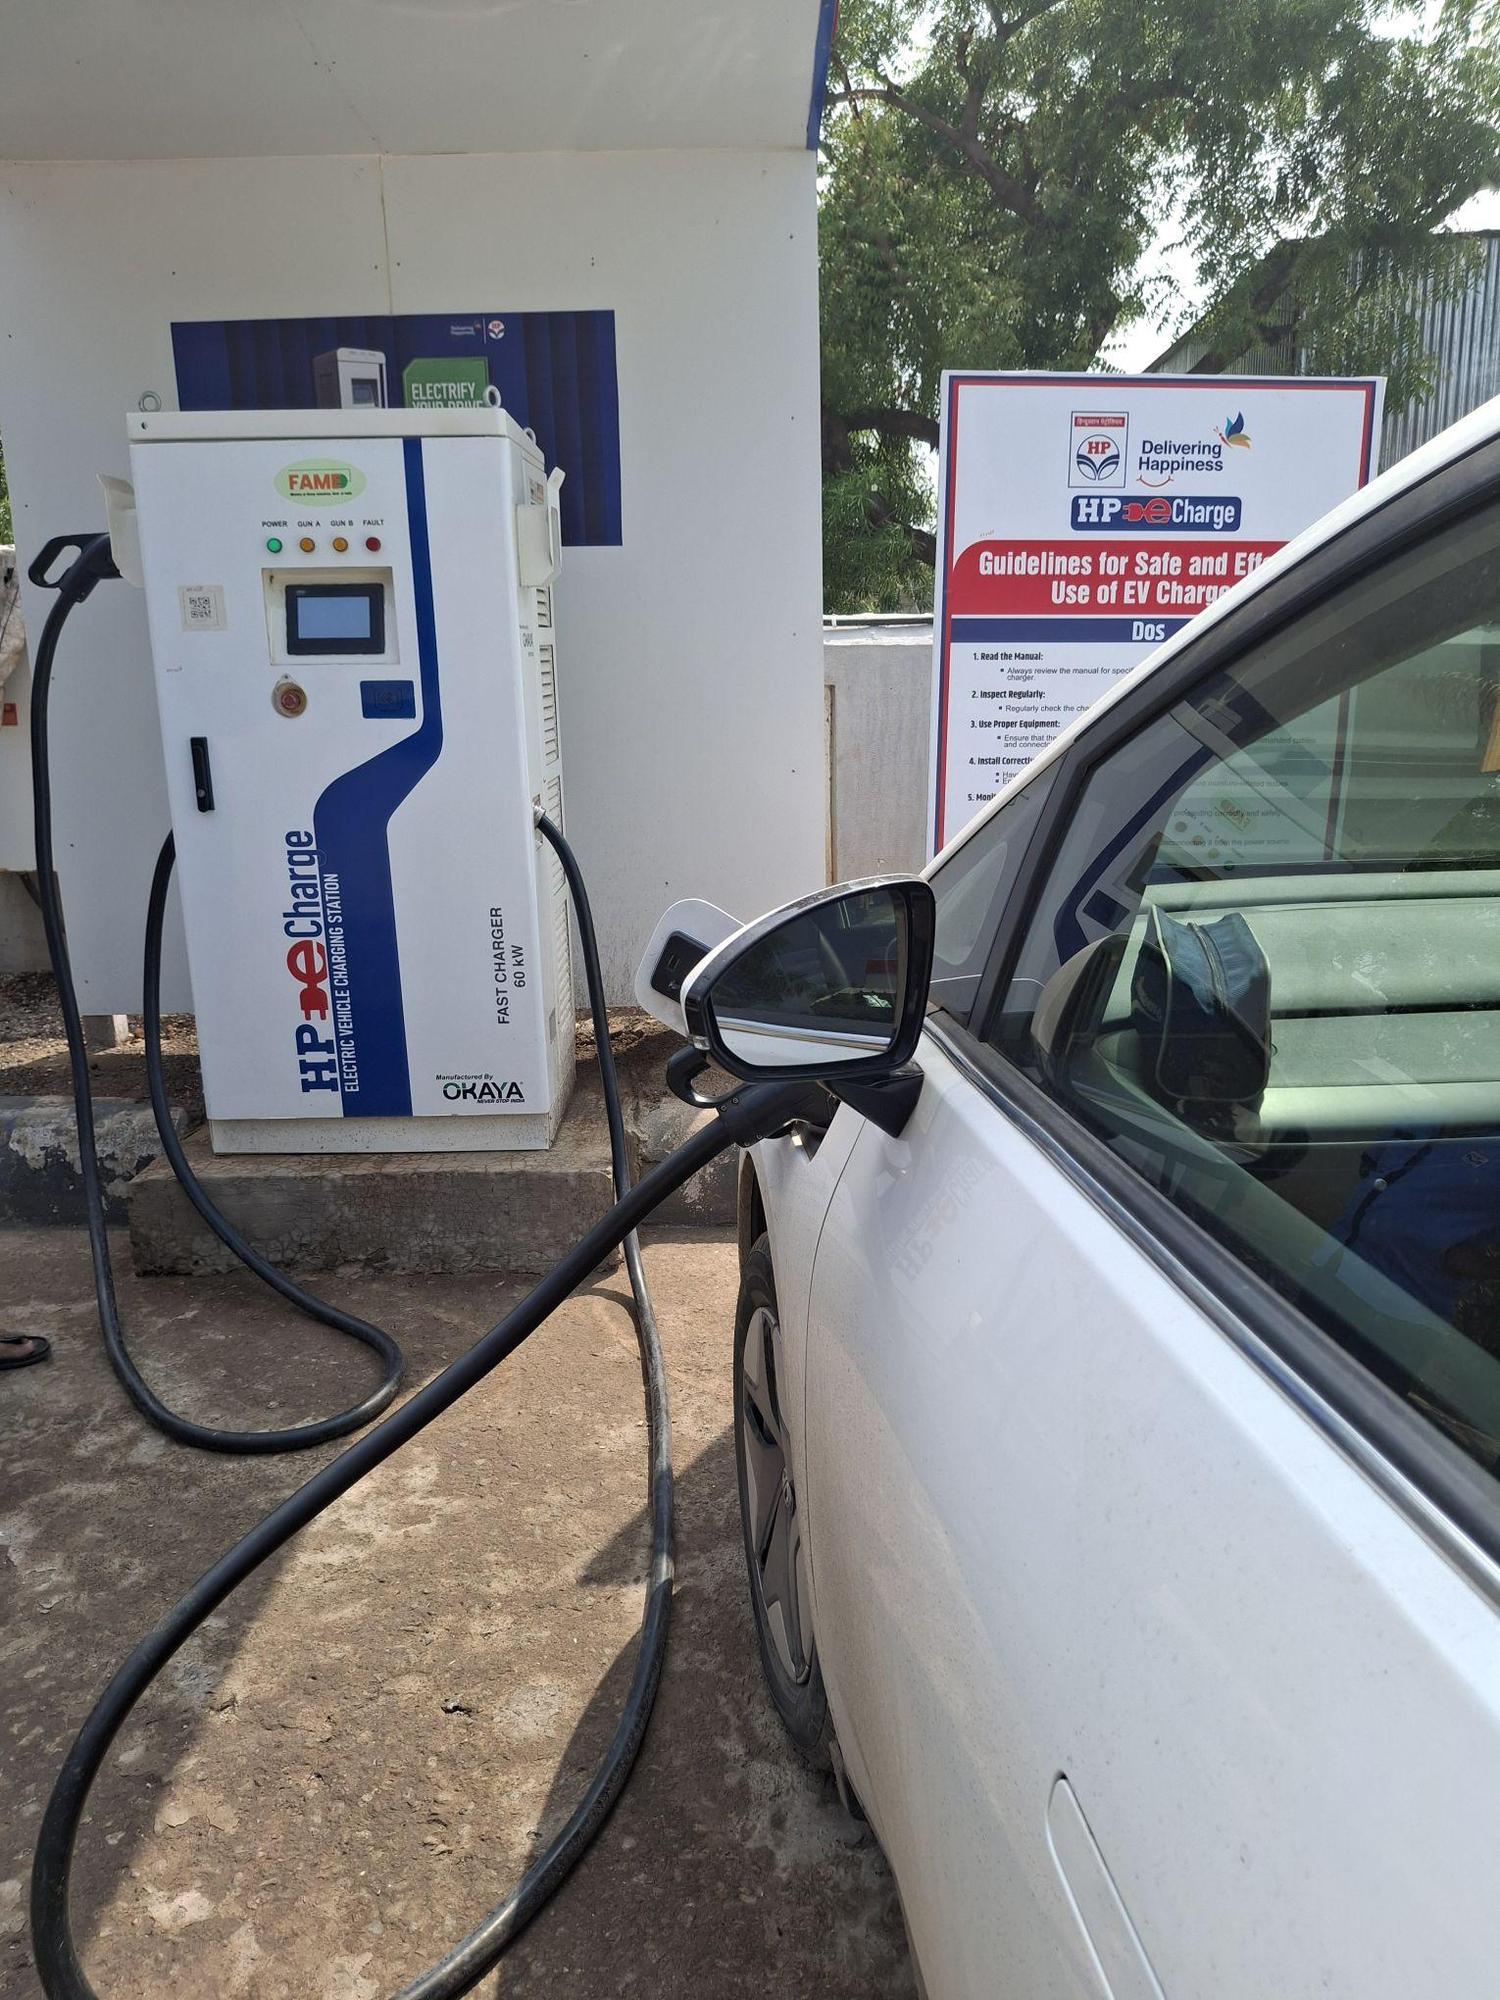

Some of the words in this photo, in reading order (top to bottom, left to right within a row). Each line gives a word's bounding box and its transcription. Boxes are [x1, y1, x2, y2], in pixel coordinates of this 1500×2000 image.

[411, 382, 476, 401] ELECTRIFY
[1087, 441, 1111, 454] HP
[1142, 440, 1222, 458] Delivering
[1138, 457, 1224, 474] Happiness
[1077, 498, 1122, 523] HP
[979, 551, 1092, 576] Guidelines
[1100, 552, 1129, 575] for
[1134, 552, 1182, 576] Safe
[1189, 552, 1228, 576] and
[1234, 552, 1272, 576] Eff
[1051, 581, 1090, 605] Use
[1096, 581, 1119, 605] of
[1123, 581, 1151, 604] EV
[1132, 621, 1165, 641] Dos
[980, 652, 999, 661] Read
[1000, 652, 1013, 661] the
[1014, 652, 1044, 661] Manual:
[1007, 667, 1033, 675] Always
[972, 691, 979, 699] 2.
[980, 690, 1007, 700] Inspect
[1008, 690, 1046, 700] Regularly:
[971, 720, 977, 728] 3.
[978, 720, 992, 728] Use
[993, 720, 1018, 730] Proper
[1019, 720, 1061, 730] Equipment:
[968, 757, 976, 765] 4.
[977, 757, 1001, 765] Install
[322, 873, 343, 923] STATION
[490, 906, 507, 983] CHARGER
[328, 926, 349, 987] CHARGING
[511, 944, 525, 967] kW
[513, 971, 526, 988] 60
[335, 989, 354, 1037] VEHICLE
[496, 987, 510, 1025] FAST
[296, 1023, 339, 1093] HP
[341, 1039, 360, 1093] ELECTRIC
[443, 1082, 524, 1100] OKAYA
